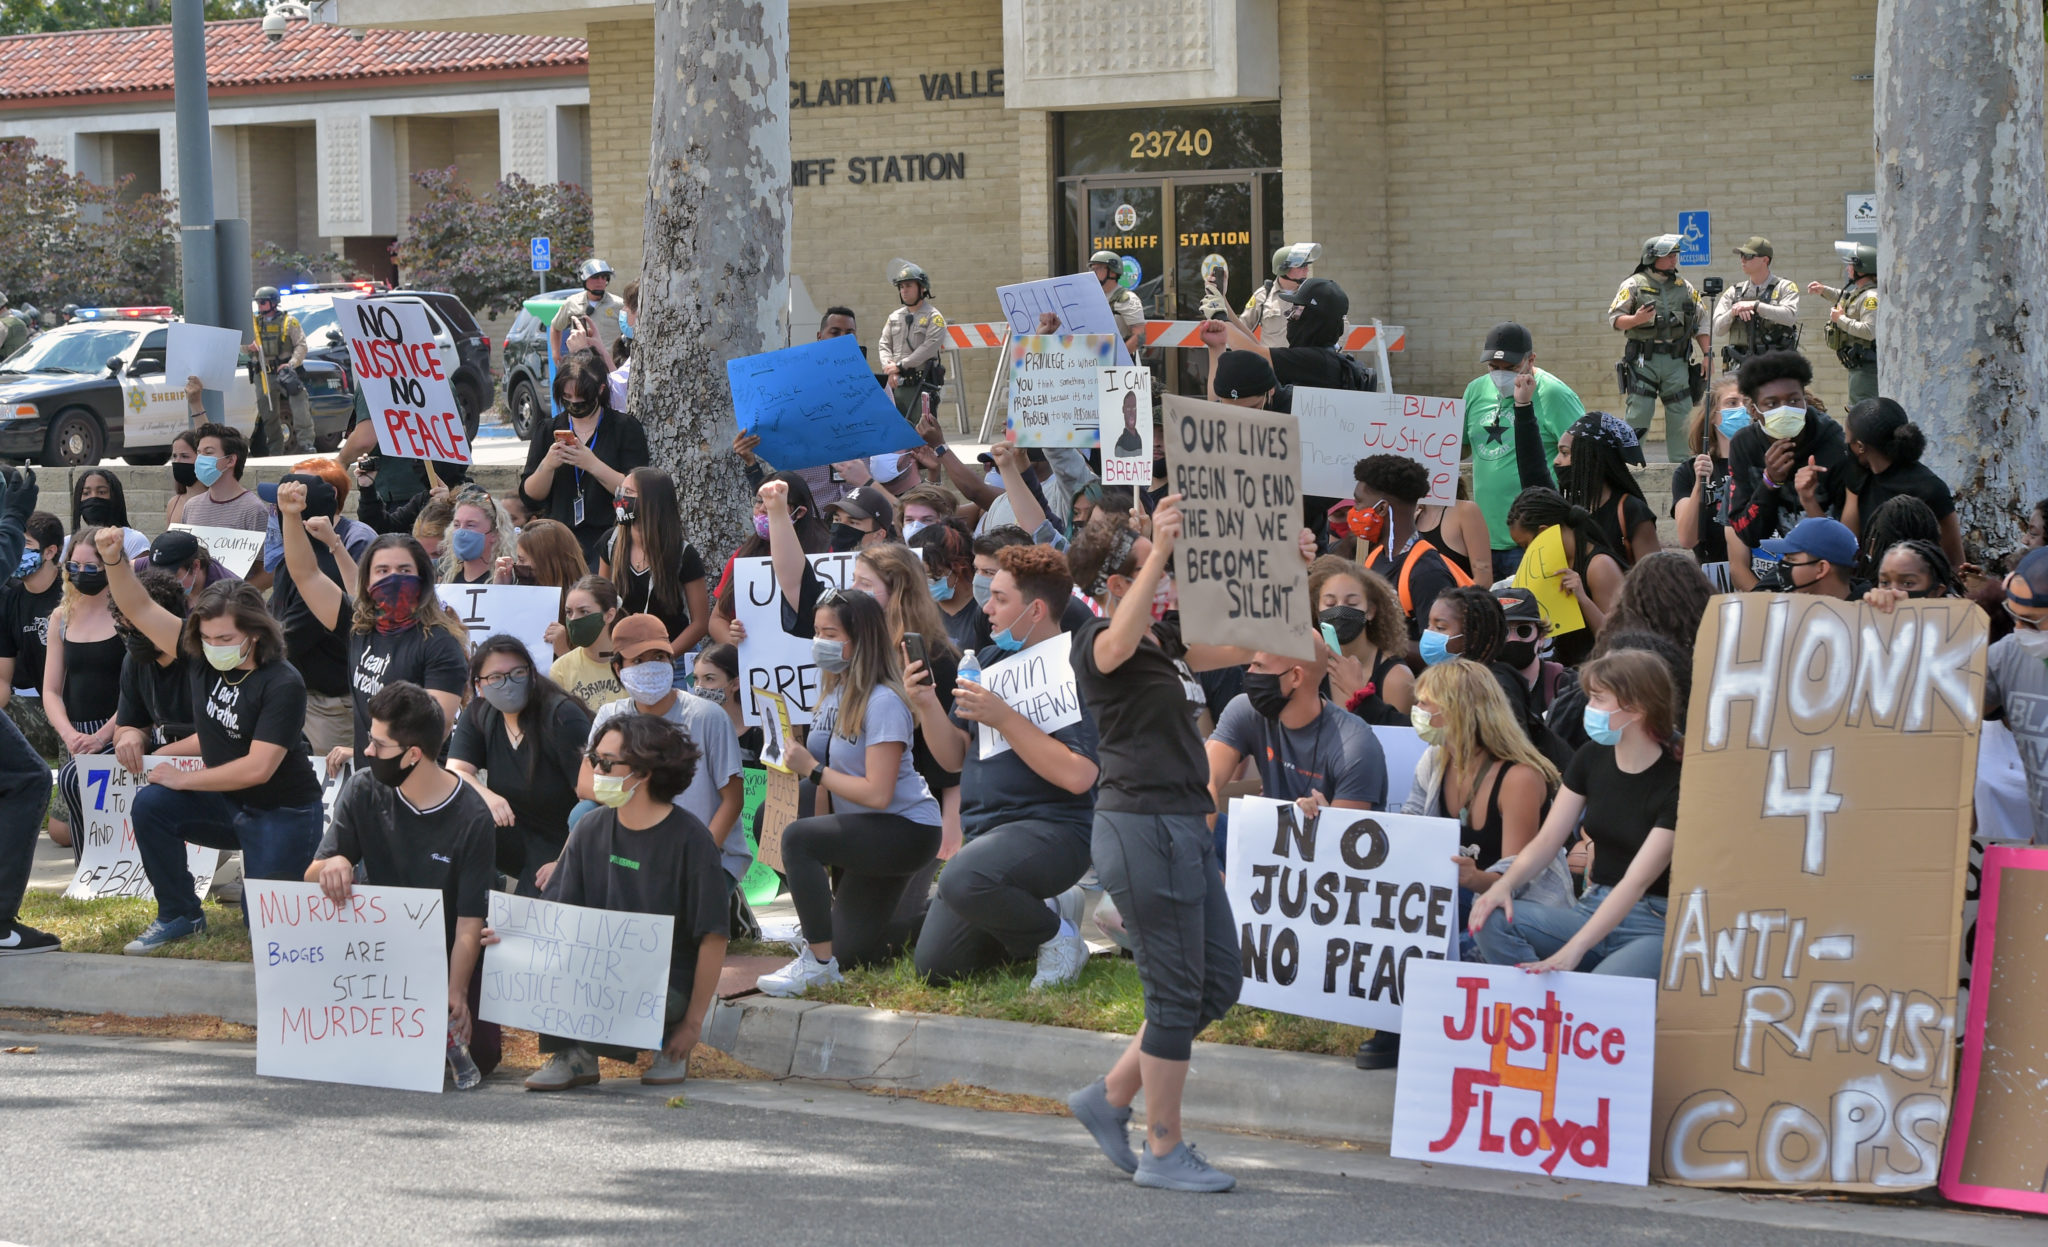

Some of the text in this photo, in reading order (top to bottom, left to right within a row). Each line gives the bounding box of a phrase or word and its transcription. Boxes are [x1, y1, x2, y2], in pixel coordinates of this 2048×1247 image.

[1129, 128, 1213, 158] 23740
[847, 152, 965, 184] STATION
[1093, 231, 1250, 249] SHERIFF STATION
[1680, 254, 1709, 263] ACCESSIBLE
[356, 304, 403, 345] NO
[351, 337, 445, 381] JUSTICE
[1025, 352, 1098, 371] PRIVILEGE is when
[152, 391, 188, 403] SHERIF
[389, 376, 426, 408] NO
[1016, 377, 1033, 394] YOU
[1037, 380, 1054, 389] think
[1060, 377, 1086, 388] something
[1104, 370, 1119, 392] I
[1013, 394, 1048, 413] PROBLEM
[1051, 411, 1060, 420] to
[1061, 412, 1072, 423] you
[1300, 393, 1337, 417] With
[384, 408, 468, 461] PEACE
[1237, 421, 1288, 460] LIVES
[1105, 459, 1151, 481] BREATHE
[1177, 464, 1295, 508] BEGIN TO END
[1181, 508, 1288, 541] THE DAY WE
[213, 536, 260, 562] country
[1186, 548, 1269, 583] BECOME
[1701, 601, 1989, 753] HONK
[112, 767, 128, 787] WE
[112, 793, 126, 813] TO
[1760, 746, 1844, 876] 4
[88, 820, 114, 847] AND
[1272, 803, 1390, 870] NO
[79, 866, 109, 886] OF
[259, 890, 387, 929] MURDERS
[1250, 864, 1453, 938] JUSTICE
[493, 894, 663, 953] BLACK LIVES
[344, 941, 386, 962] ARE
[529, 939, 624, 983] MATTER
[1241, 922, 1446, 1006] NO PEA
[333, 974, 419, 1002] STILL
[486, 970, 666, 1023] JUSTICE MUST BE
[281, 1006, 426, 1045] MURDERS
[527, 1005, 614, 1039] SERVED!
[1443, 976, 1626, 1065] Justice
[1662, 1080, 1948, 1187] COPS
